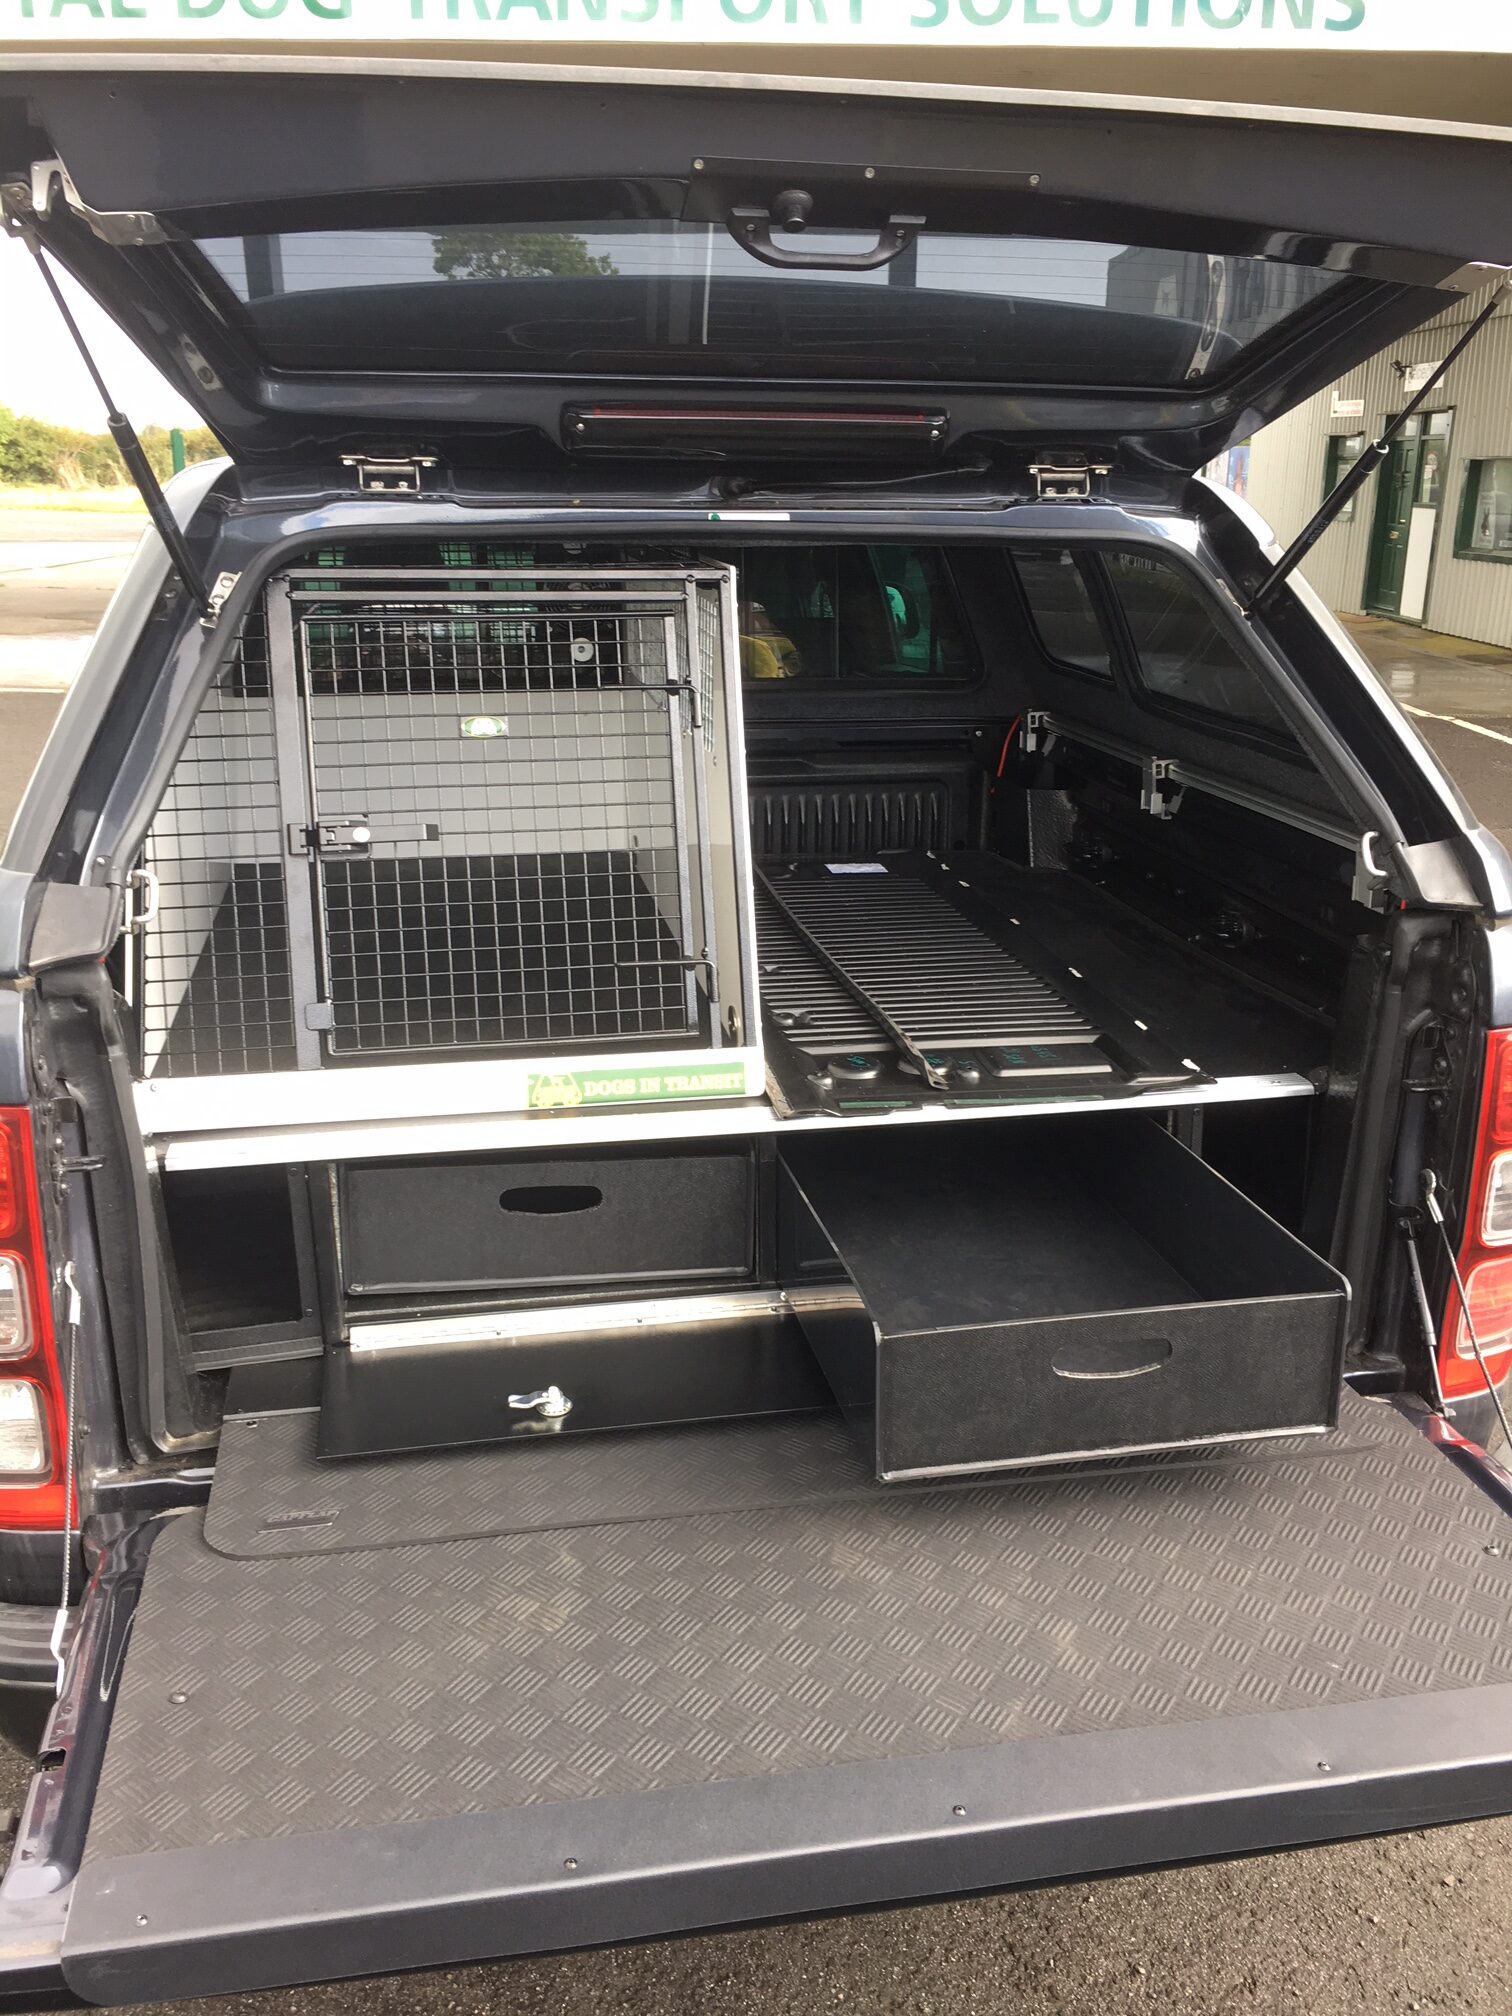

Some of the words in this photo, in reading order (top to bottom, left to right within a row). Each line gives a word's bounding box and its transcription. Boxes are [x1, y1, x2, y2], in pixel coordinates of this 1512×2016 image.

[584, 1079, 636, 1096] DOGS
[639, 1077, 661, 1093] IN
[664, 1073, 743, 1091] TRANSIT
